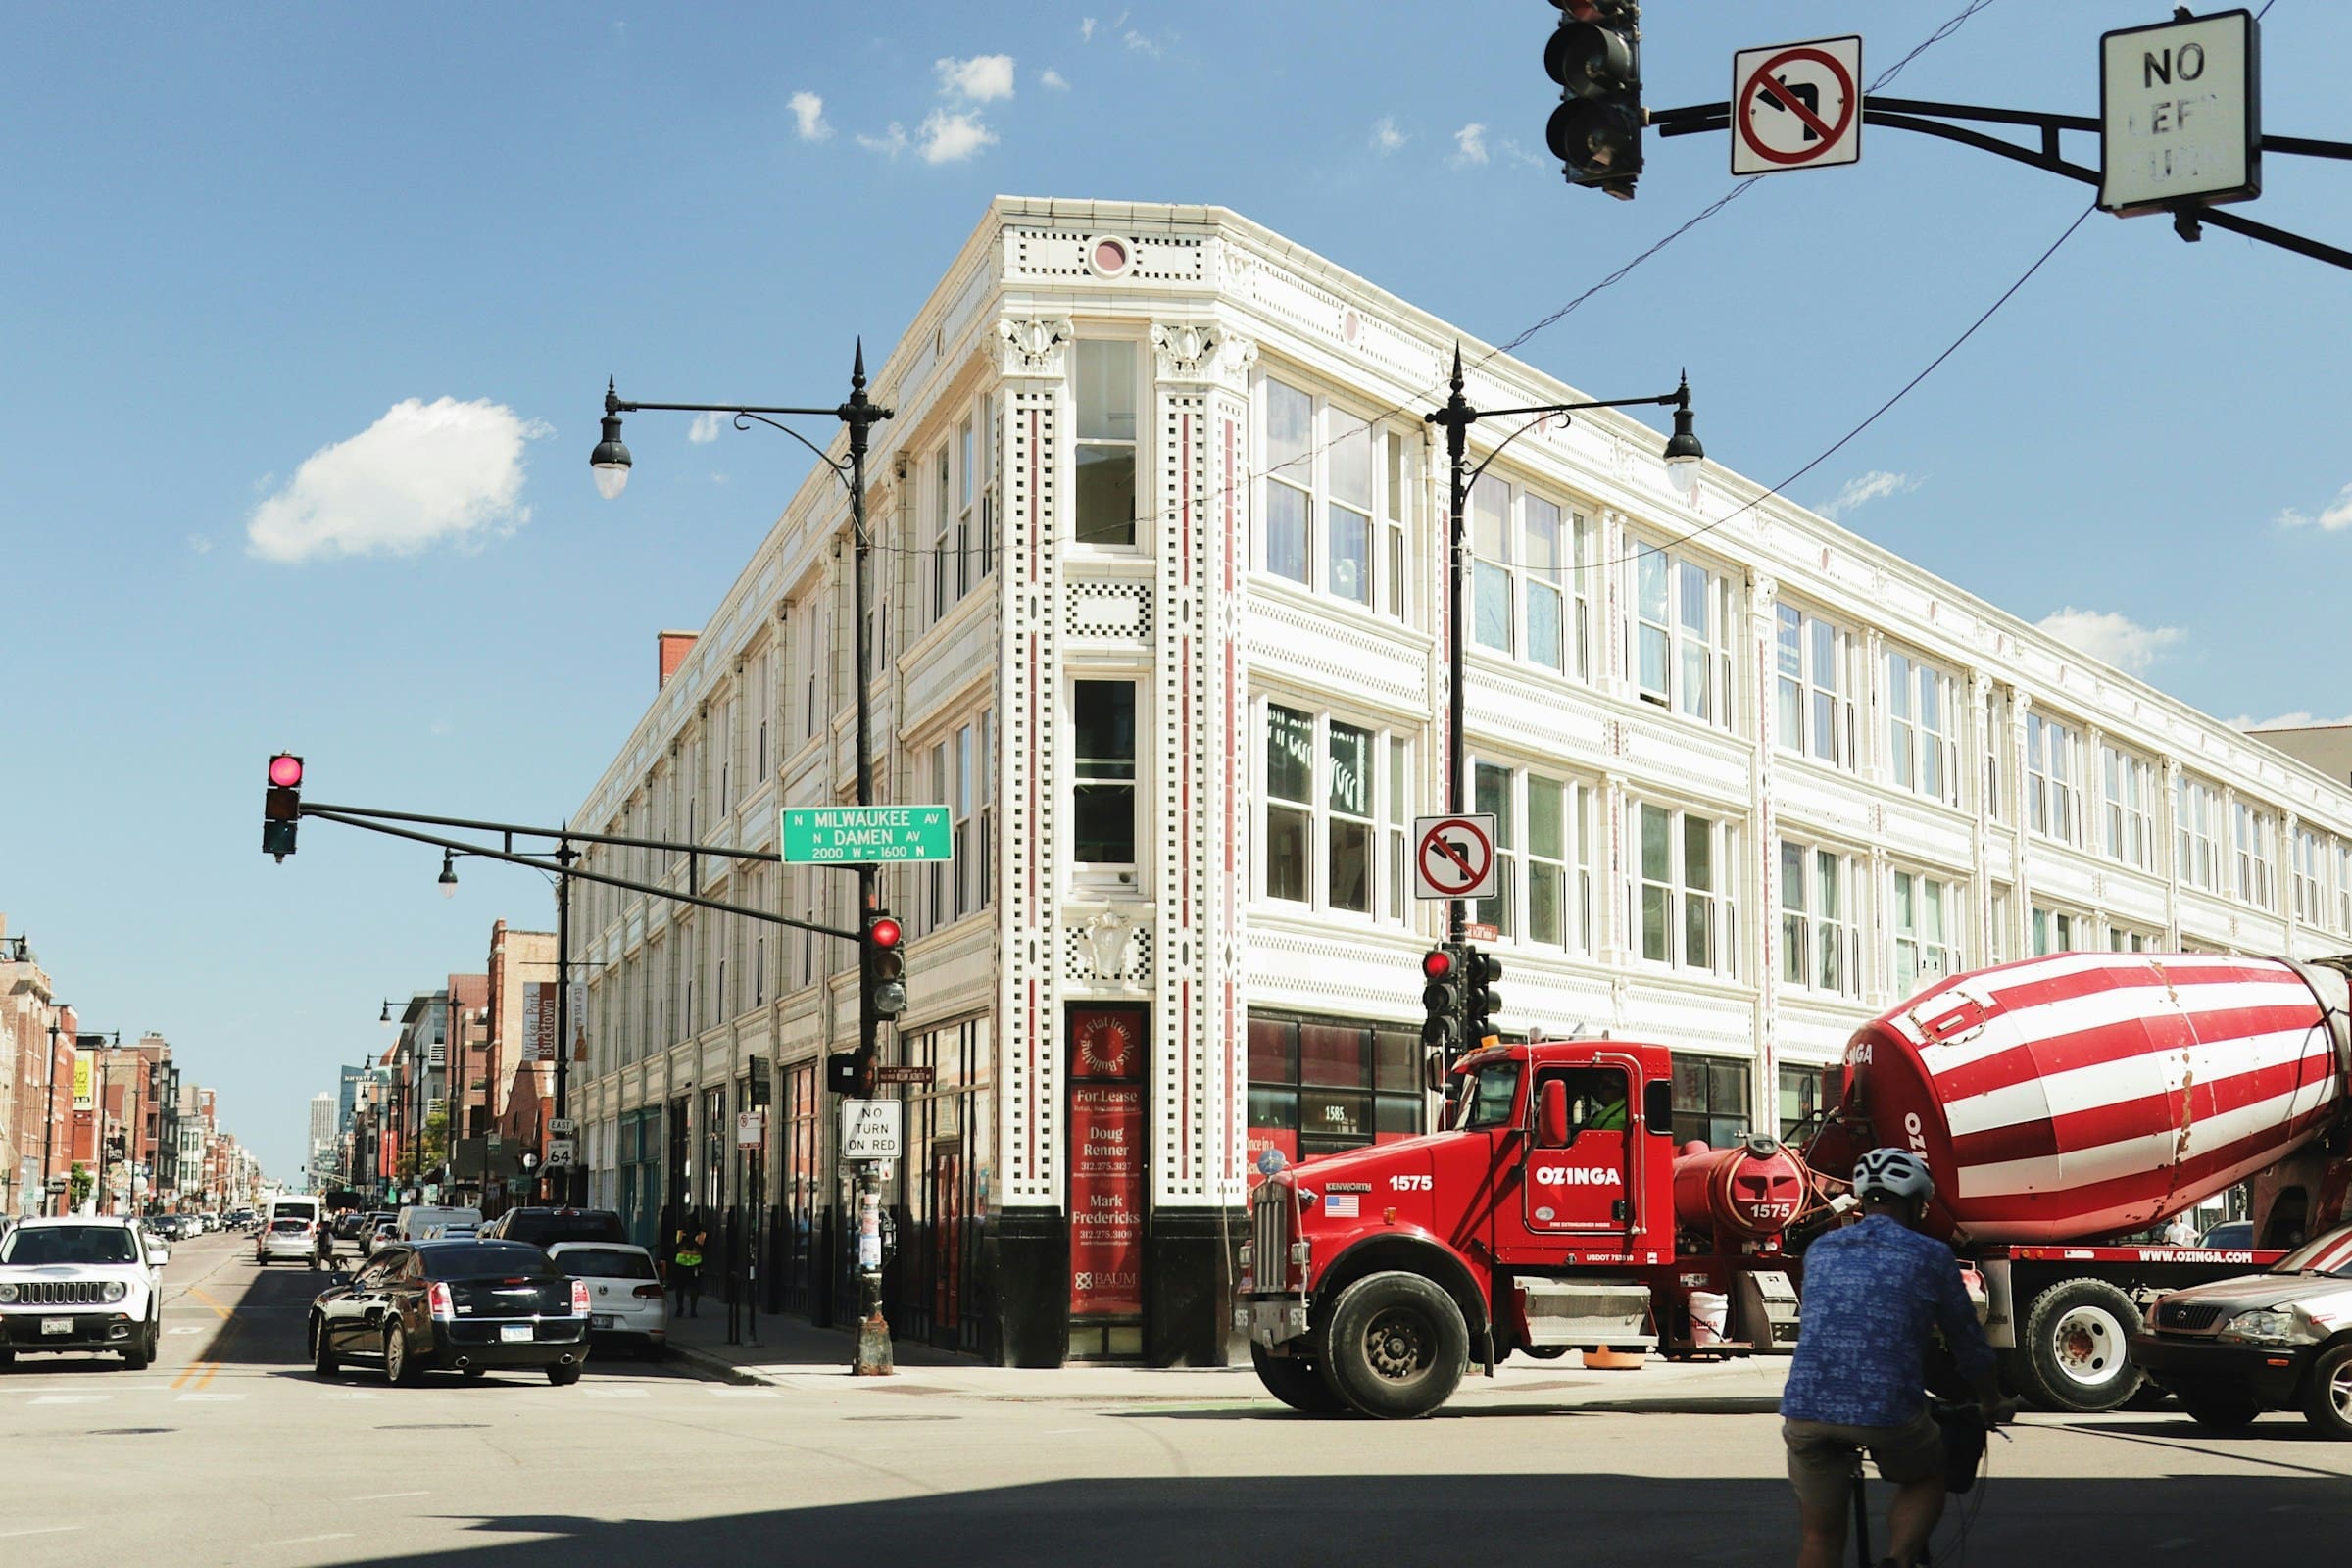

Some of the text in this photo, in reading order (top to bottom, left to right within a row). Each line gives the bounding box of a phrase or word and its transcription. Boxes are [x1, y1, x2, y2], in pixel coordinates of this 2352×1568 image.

[2144, 43, 2205, 88] NO
[794, 811, 939, 828] N MILWAUKEE AV
[813, 830, 921, 846] N DAMEN AV
[812, 848, 844, 858] 2000
[852, 848, 861, 858] W
[881, 847, 907, 858] 1600
[916, 846, 925, 857] N
[525, 991, 540, 1056] Wicker Park
[539, 1000, 554, 1055] Bucktown
[1086, 1017, 1108, 1033] Flat
[1110, 1017, 1131, 1041] Iron
[1080, 1039, 1117, 1072] Building
[1077, 1089, 1137, 1102] For Lease
[862, 1107, 882, 1118] NO
[1325, 1105, 1345, 1121] 1585
[857, 1123, 888, 1134] TURN
[1090, 1127, 1124, 1143] Doug
[849, 1139, 895, 1151] ON RED
[1084, 1143, 1129, 1156] Renner
[551, 1151, 571, 1162] 64
[1389, 1175, 1433, 1191] 1575
[1536, 1166, 1621, 1185] OZINGA
[1325, 1182, 1372, 1192] KENWORTH
[1090, 1194, 1122, 1207] Mark
[1073, 1210, 1140, 1224] Fredericks
[1750, 1203, 1790, 1218] 1575
[2139, 1250, 2253, 1263] WWW.OZINGA.COM
[1095, 1273, 1136, 1285] BAUM
